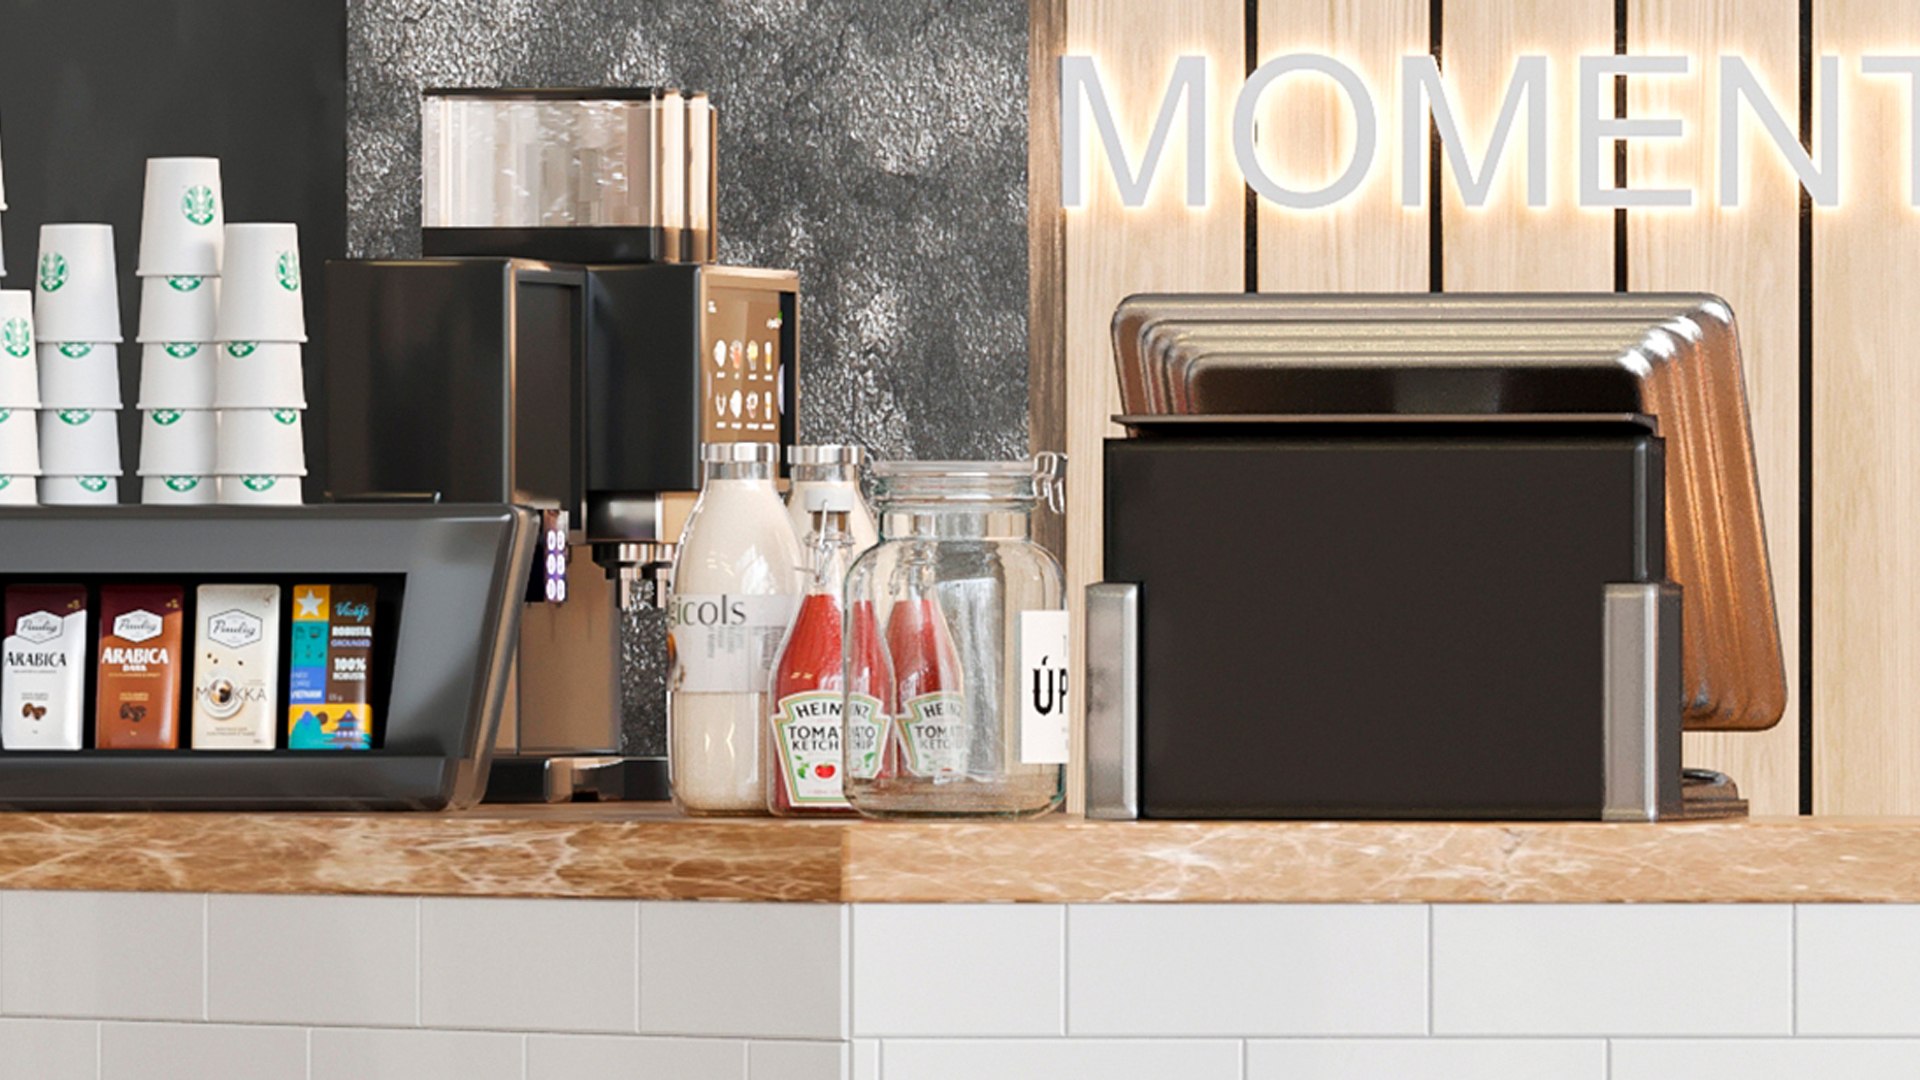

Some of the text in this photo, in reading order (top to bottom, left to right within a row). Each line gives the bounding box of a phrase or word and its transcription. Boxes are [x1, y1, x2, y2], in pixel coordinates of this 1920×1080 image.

[5, 652, 67, 667] ARABICA
[101, 646, 168, 664] ARABICA
[334, 657, 367, 671] 100%
